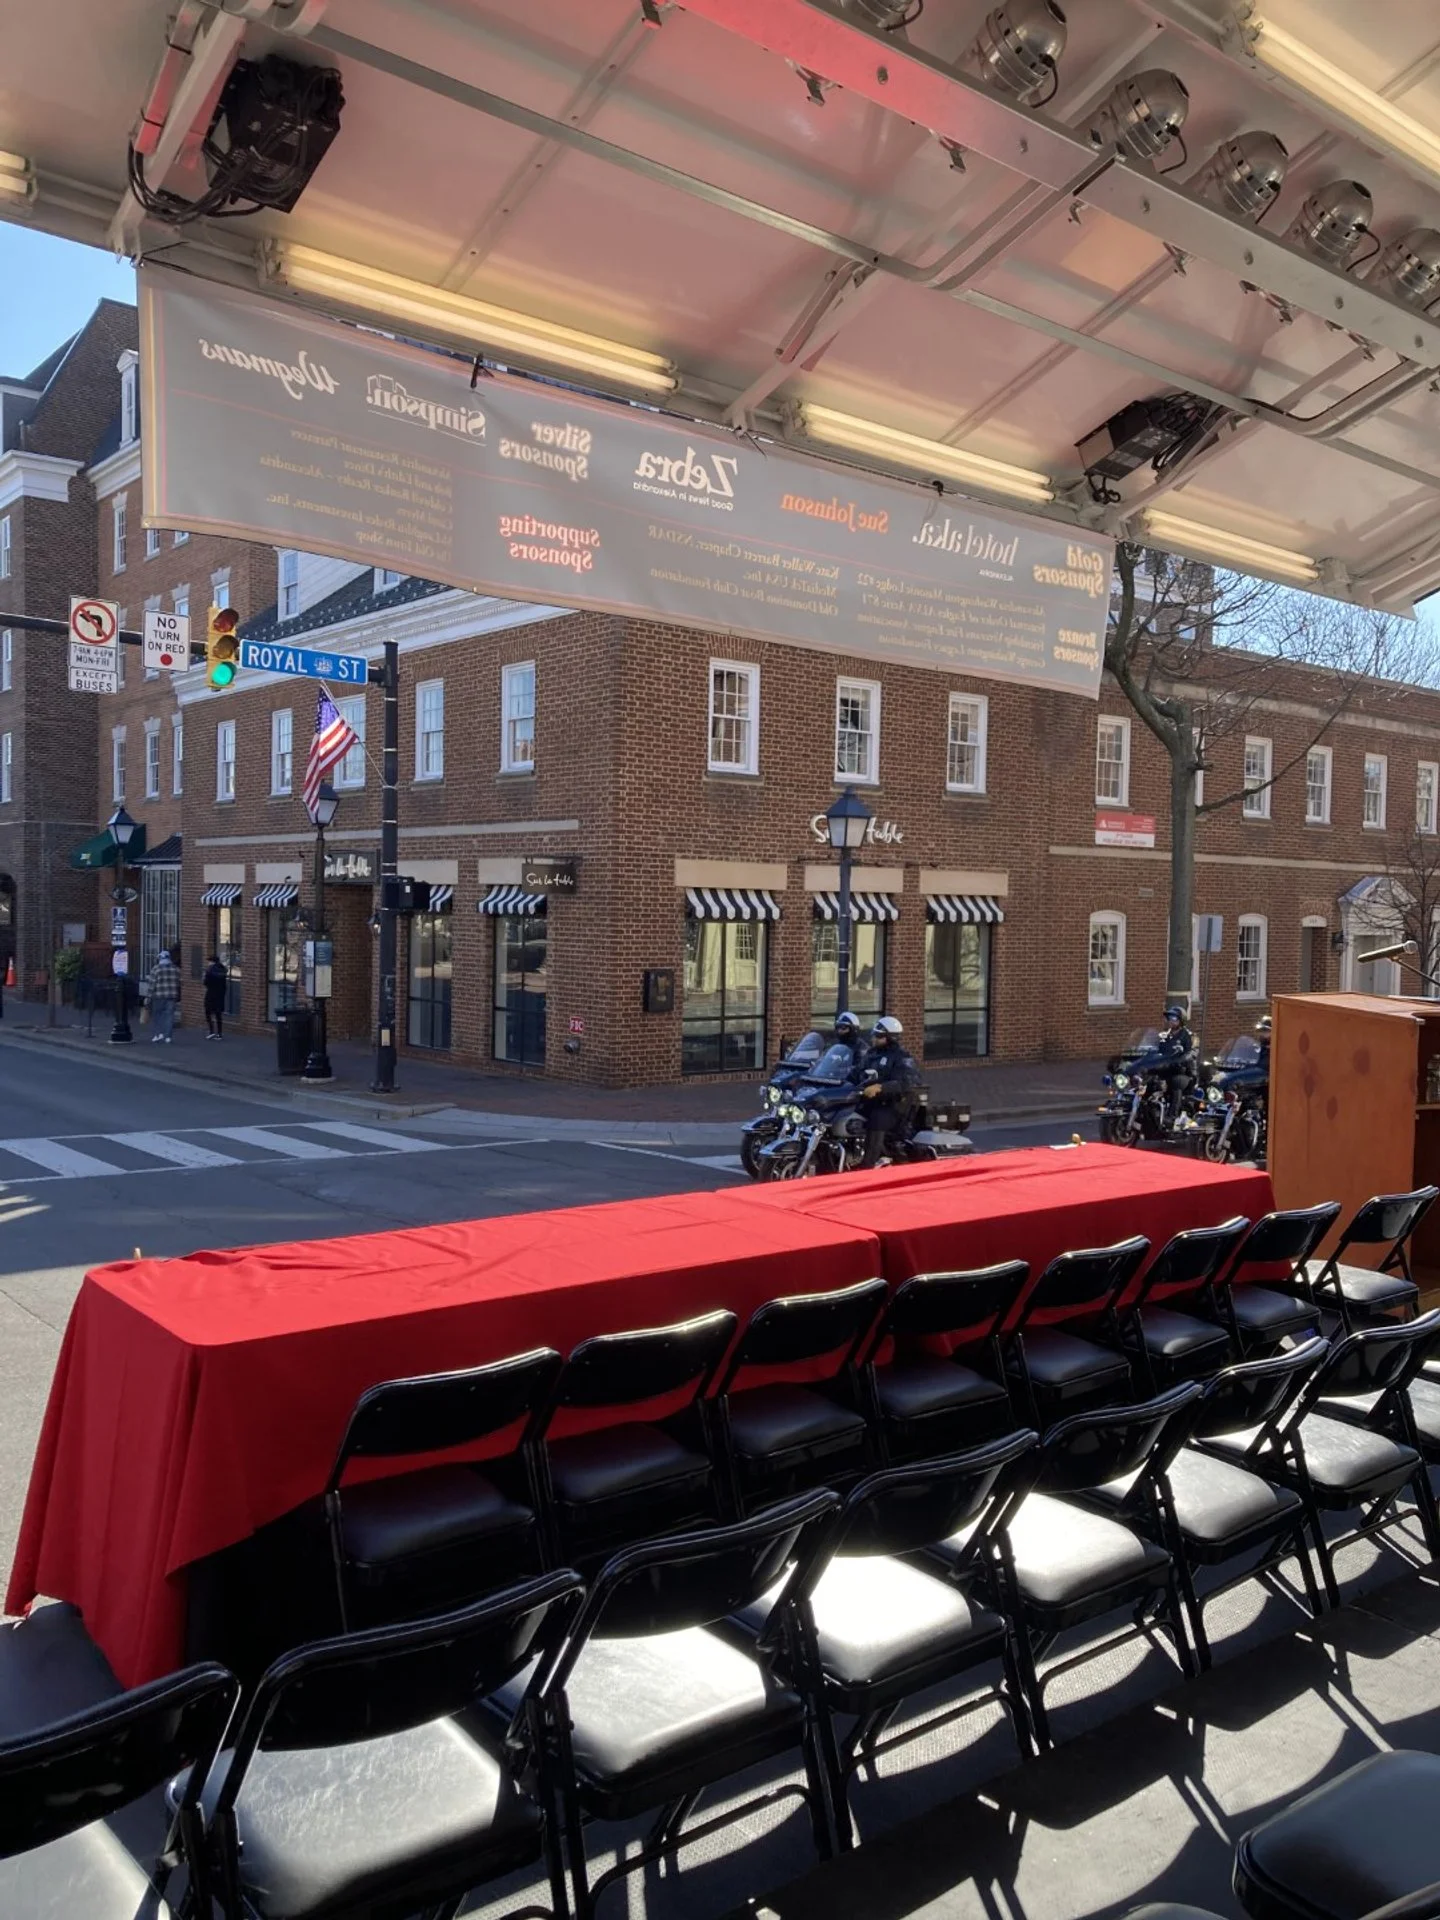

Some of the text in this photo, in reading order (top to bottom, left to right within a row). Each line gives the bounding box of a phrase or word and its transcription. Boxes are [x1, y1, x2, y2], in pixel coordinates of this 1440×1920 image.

[157, 617, 177, 630] NO
[153, 629, 180, 642] TURN
[148, 641, 186, 655] ON RED
[248, 645, 361, 680] ROYAL ST
[76, 669, 113, 681] EXCEPT
[76, 679, 113, 692] BUSES
